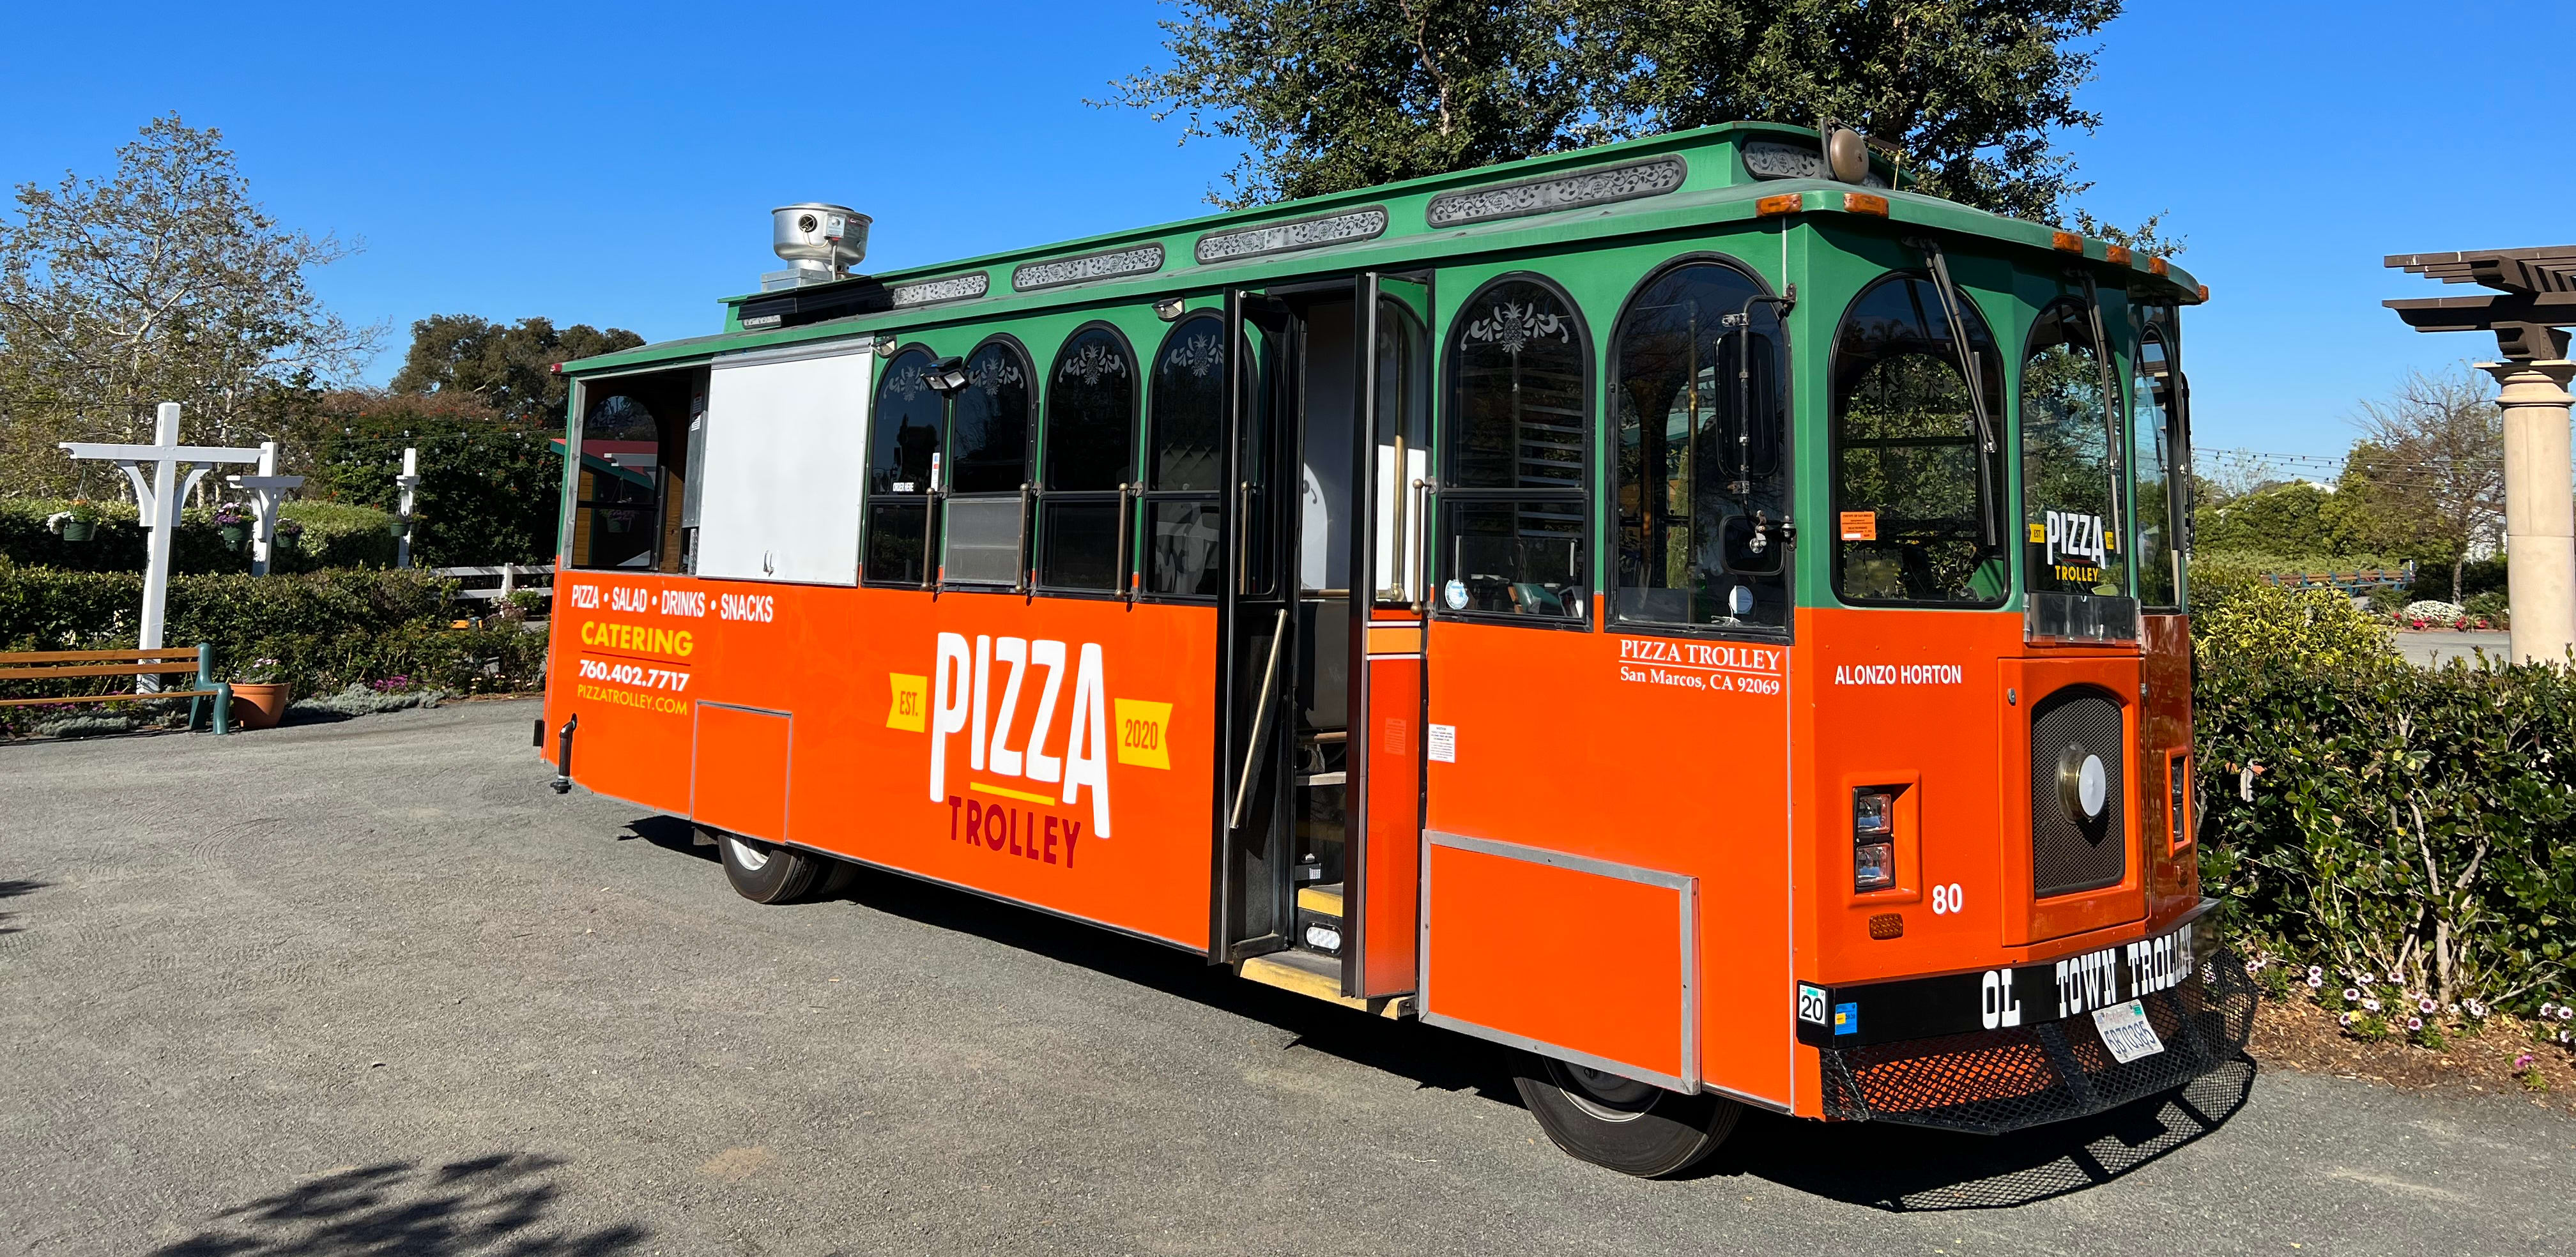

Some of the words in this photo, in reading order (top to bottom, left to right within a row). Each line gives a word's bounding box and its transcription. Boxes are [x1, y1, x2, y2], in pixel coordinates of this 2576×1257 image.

[2046, 510, 2106, 570] PIZZA
[2055, 565, 2099, 582] TROLLEY
[571, 584, 599, 609] PIZZA
[611, 586, 647, 613] SALAD
[661, 590, 705, 618] DRINKS
[720, 593, 773, 623] SNACKS
[581, 621, 693, 657] CATERING
[1620, 639, 1682, 662] PIZZA
[1685, 644, 1781, 670] TROLLEY
[579, 659, 690, 692] 760.402.7717
[1620, 666, 1646, 682] San
[1650, 668, 1706, 690] Marcos,
[1710, 674, 1734, 690] CA
[1737, 677, 1780, 696] 92069
[1834, 664, 1896, 685] ALONZO
[1900, 664, 1962, 685] HORTON
[578, 684, 687, 715] PIZZATROLLEY.COM
[900, 690, 918, 717] EST.
[930, 632, 1110, 839] PIZZA
[1124, 719, 1158, 750] 2020
[949, 795, 1081, 869] TROLLEY
[1932, 883, 1963, 915] 80
[1981, 968, 2020, 1029] OL
[2056, 948, 2116, 1018] TOWN
[1801, 994, 1823, 1021] 20
